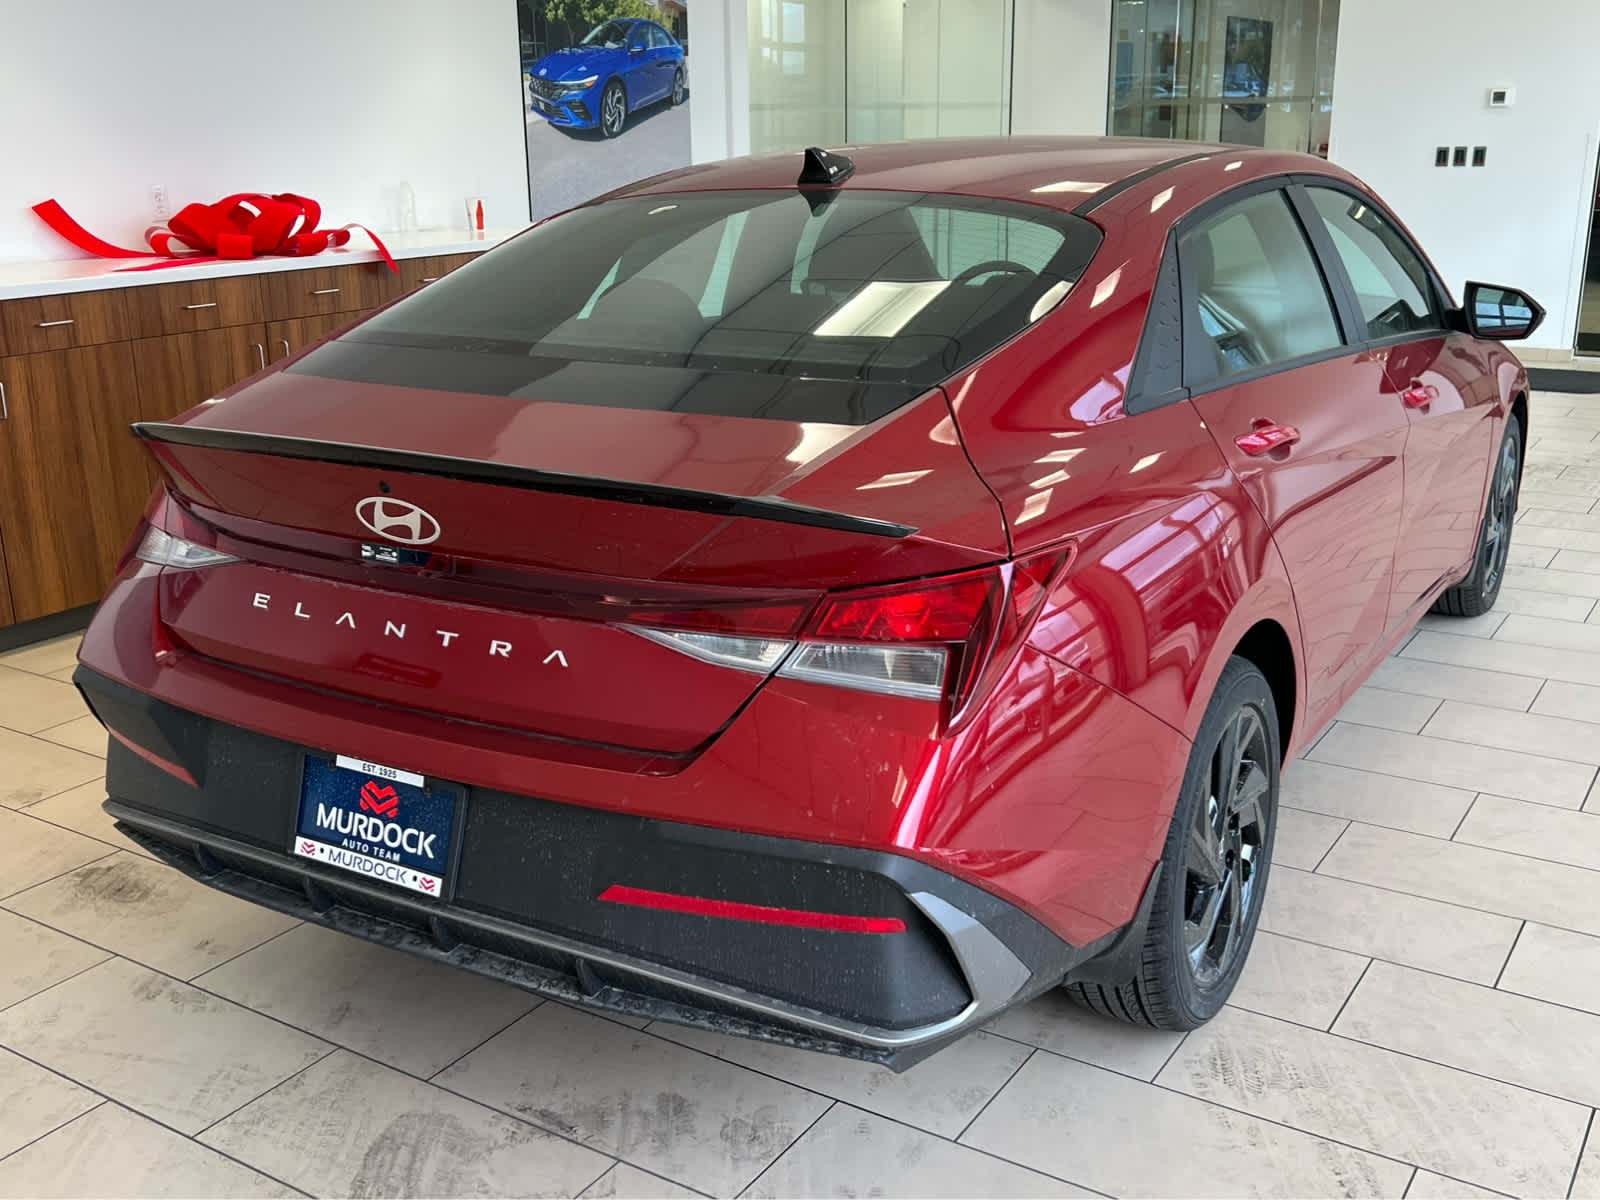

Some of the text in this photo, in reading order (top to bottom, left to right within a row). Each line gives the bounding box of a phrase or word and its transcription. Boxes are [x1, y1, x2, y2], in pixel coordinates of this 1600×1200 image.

[253, 592, 569, 667] ELANTRA
[362, 764, 397, 779] EST. 1925
[316, 803, 437, 859] MURDOCK
[328, 848, 408, 884] MURDOCK
[342, 838, 401, 861] AUTO TEAM
